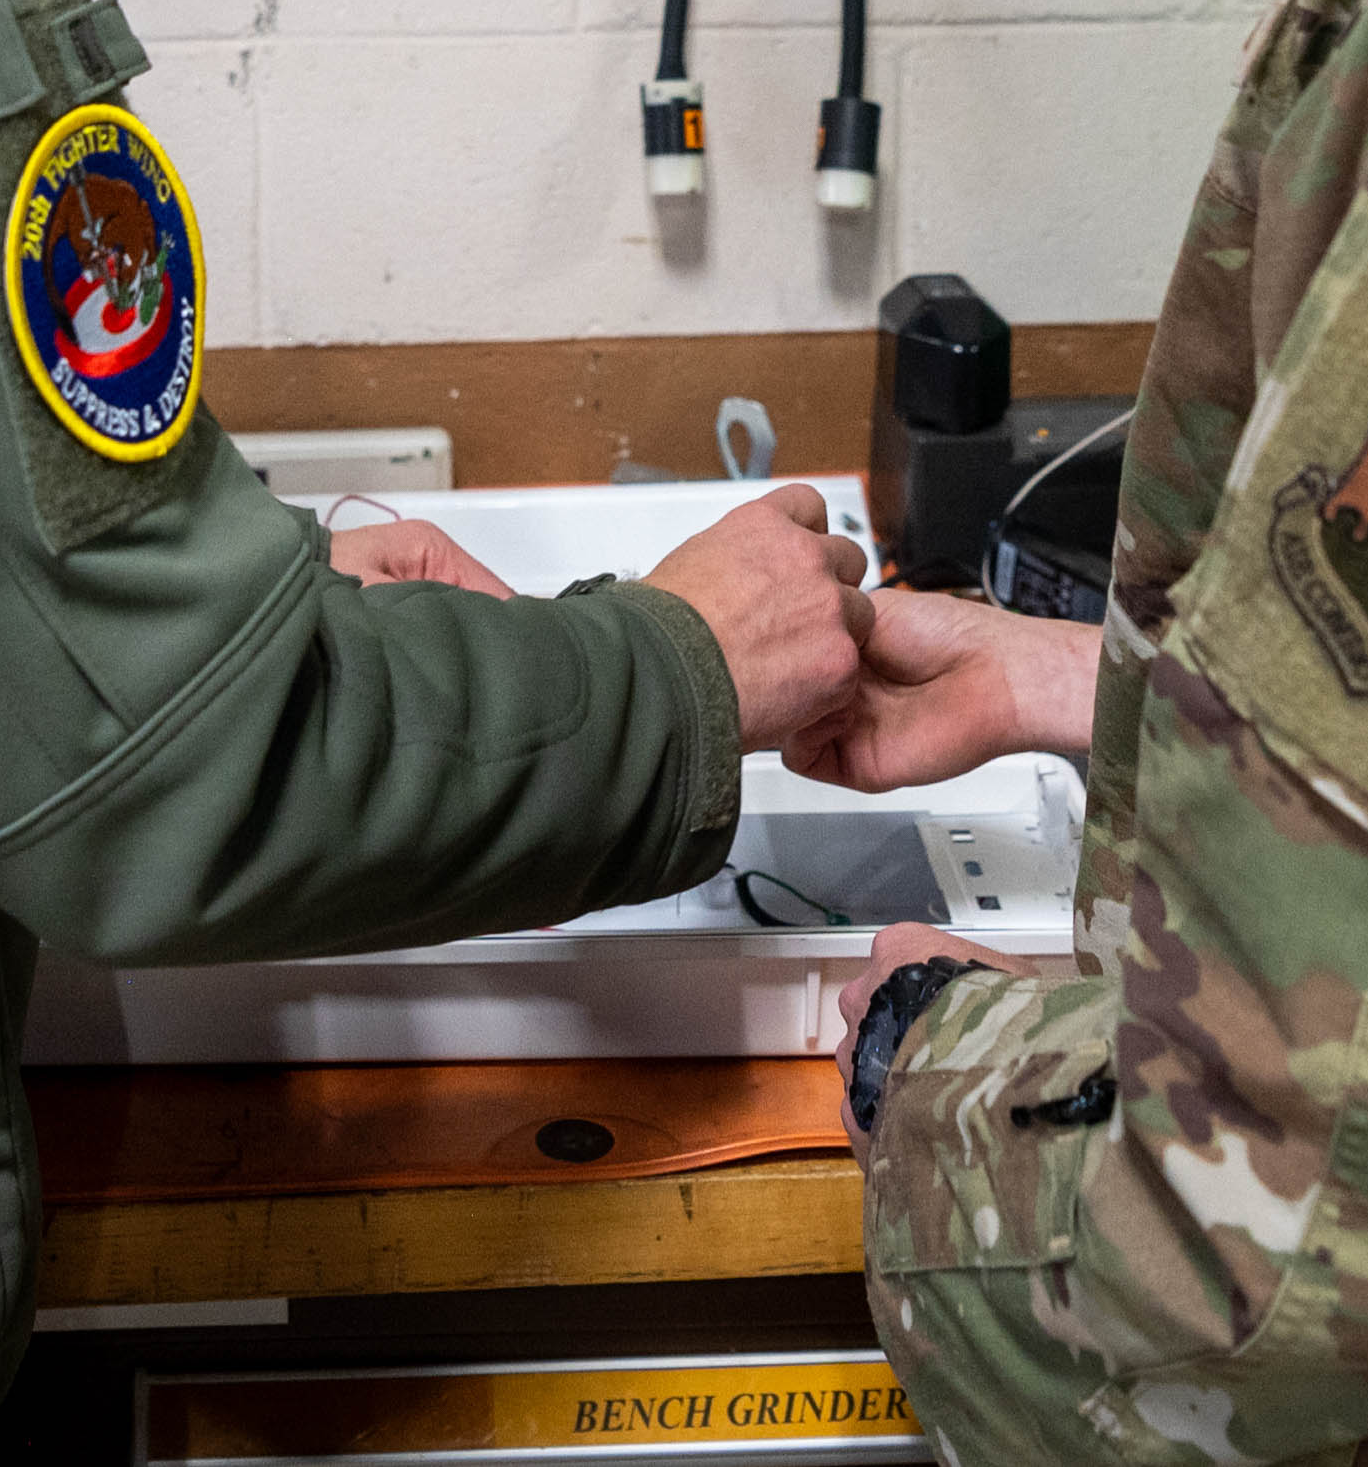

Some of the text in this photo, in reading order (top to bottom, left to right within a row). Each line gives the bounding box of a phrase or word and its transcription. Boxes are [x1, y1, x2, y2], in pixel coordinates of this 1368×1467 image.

[42, 125, 120, 191] FIGHTER
[51, 296, 194, 437] SUPPRESS & DESTROY
[573, 1386, 910, 1433] BENCH GRINDER
